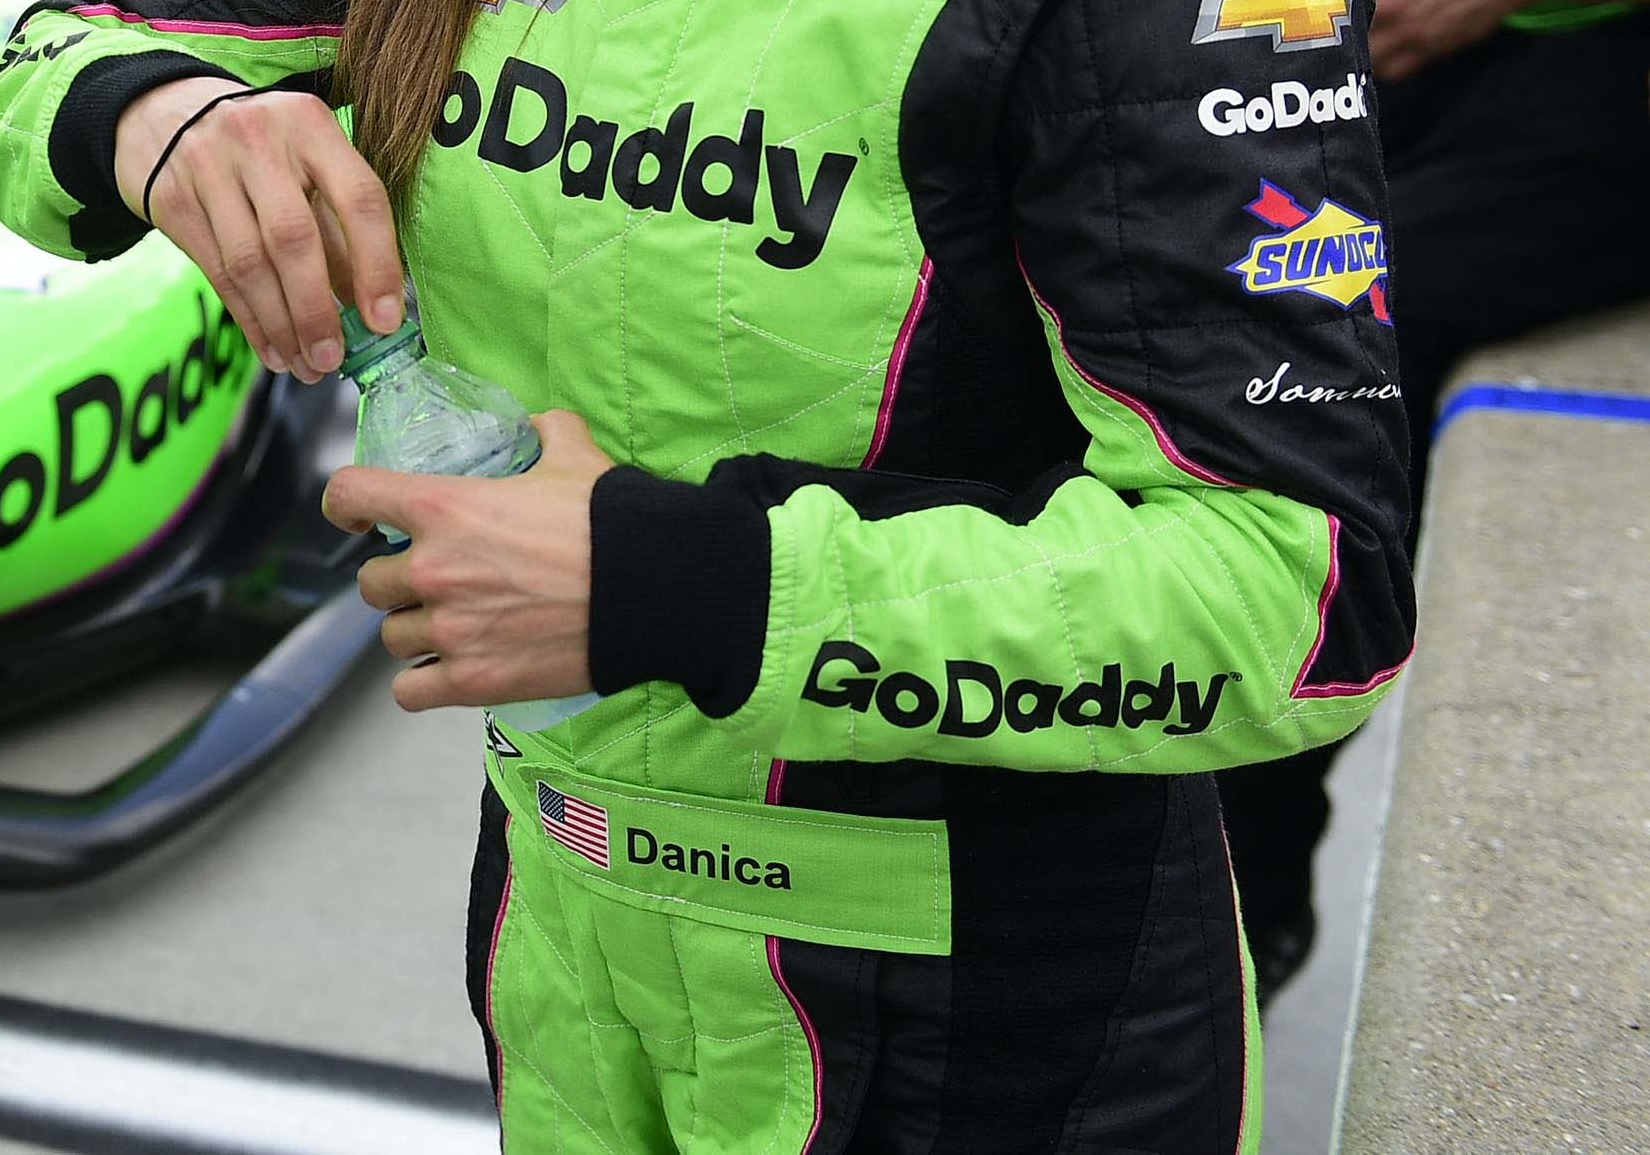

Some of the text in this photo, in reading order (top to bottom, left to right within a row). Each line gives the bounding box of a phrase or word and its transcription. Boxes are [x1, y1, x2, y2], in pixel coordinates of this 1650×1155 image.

[430, 57, 858, 270] oDaddy
[801, 641, 1230, 737] GoDaddy
[627, 828, 792, 890] Danica
